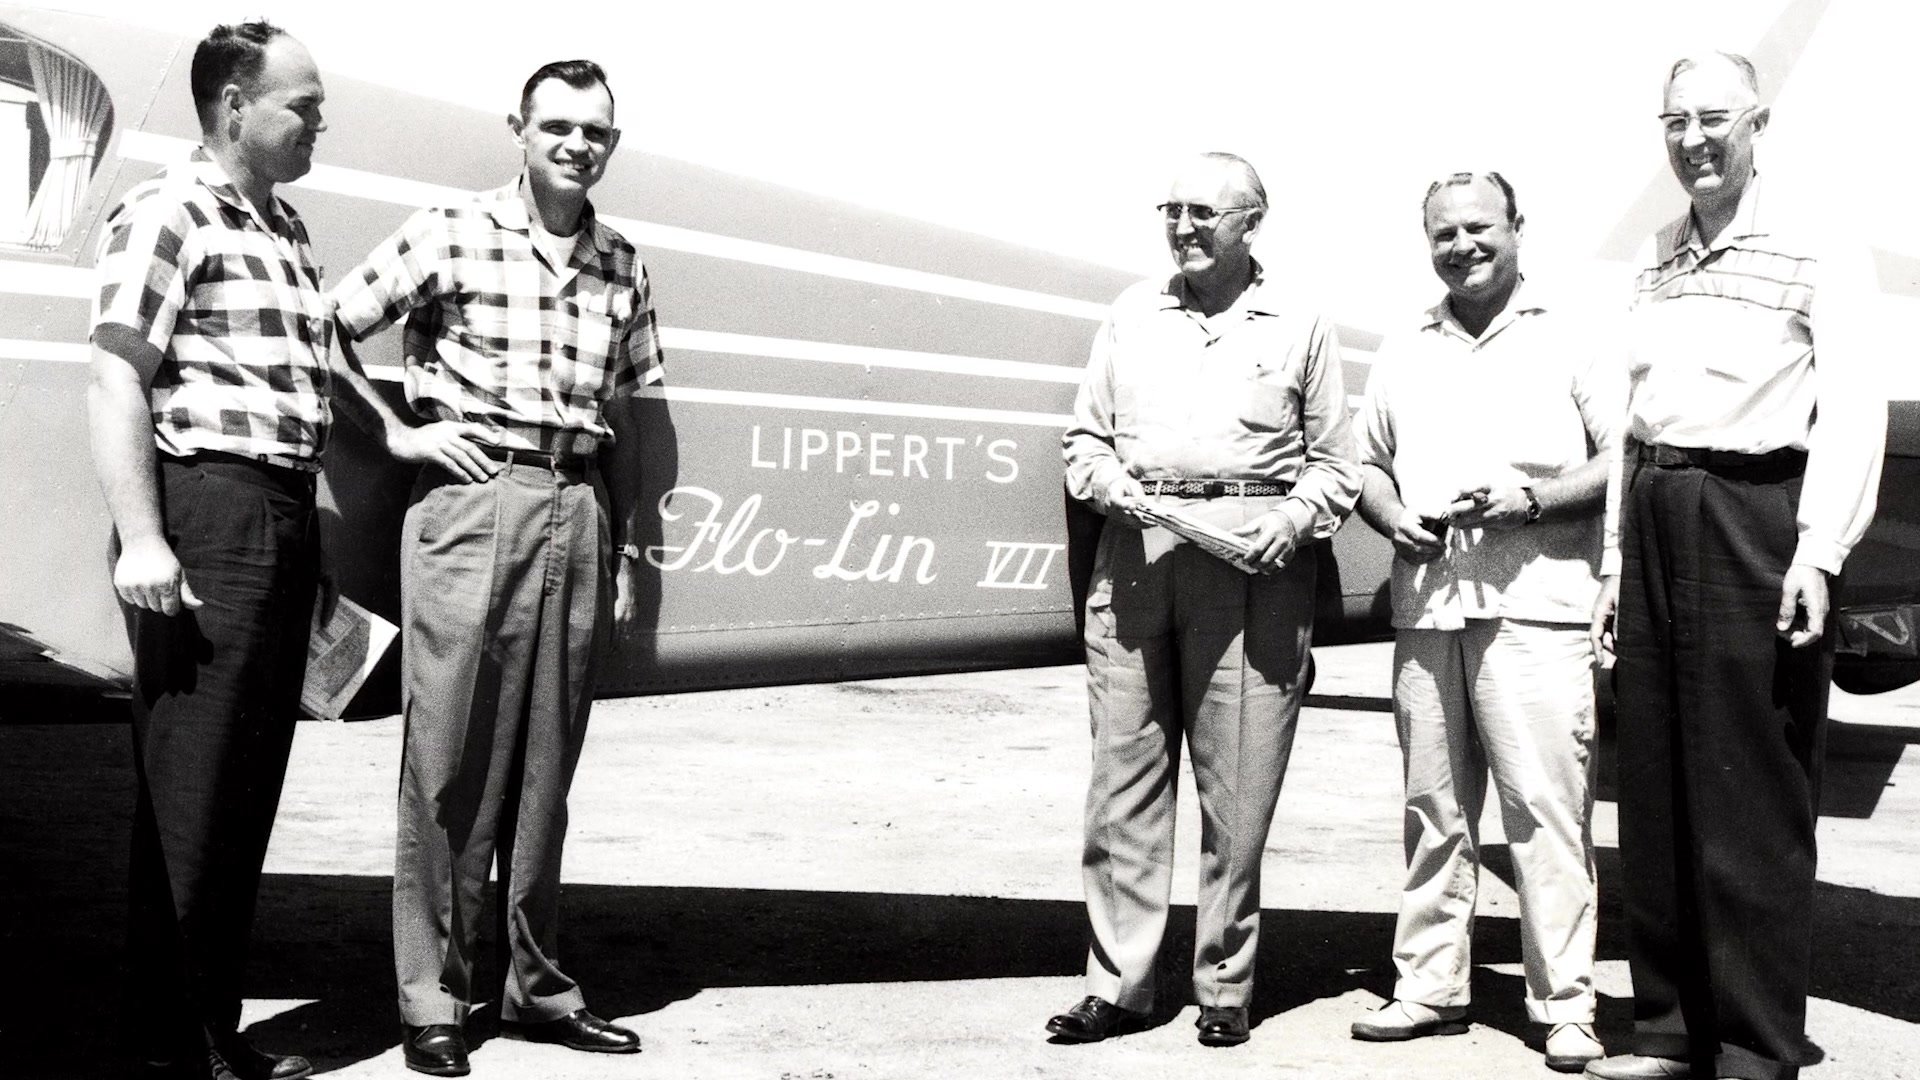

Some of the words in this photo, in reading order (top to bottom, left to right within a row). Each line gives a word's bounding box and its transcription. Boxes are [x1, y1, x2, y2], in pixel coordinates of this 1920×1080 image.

[751, 425, 1020, 484] LIPPERT'S
[645, 486, 938, 585] Flo-Lin
[976, 541, 1066, 590] VII
